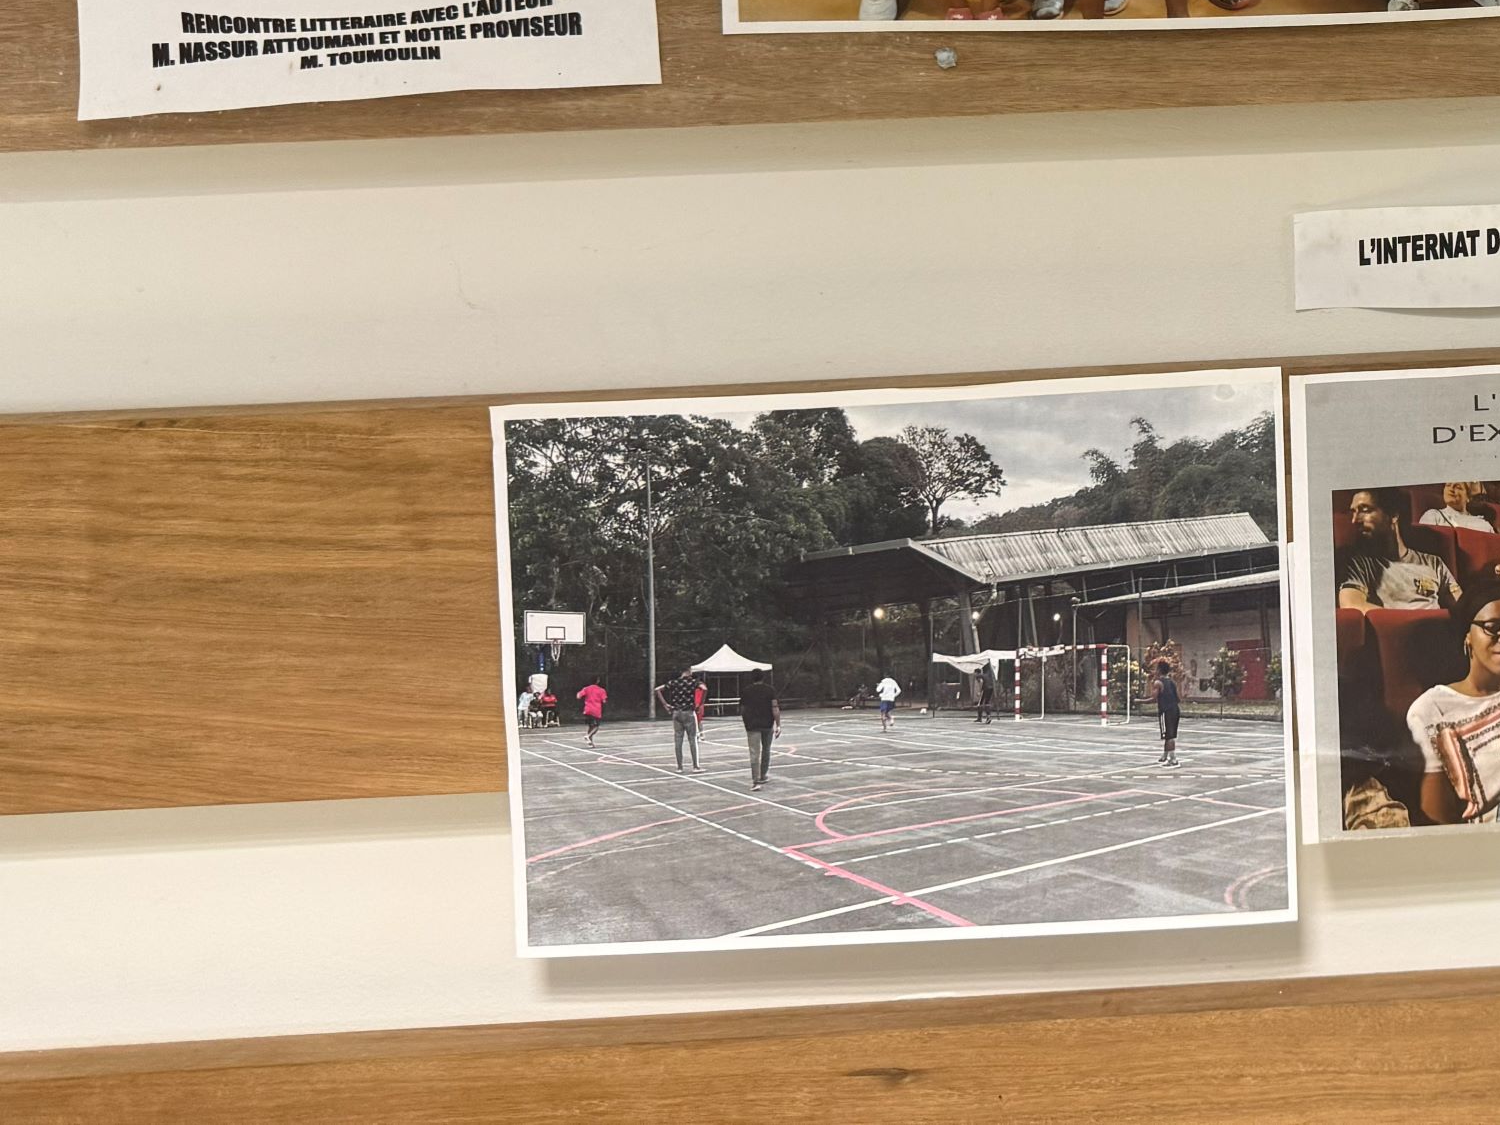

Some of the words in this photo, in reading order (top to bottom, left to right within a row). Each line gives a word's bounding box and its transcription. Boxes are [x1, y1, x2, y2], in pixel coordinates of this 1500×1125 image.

[180, 11, 298, 34] RENCONTRE
[299, 12, 408, 33] LITTERAIRE
[410, 4, 460, 24] AVEC
[151, 42, 177, 68] M.
[179, 39, 260, 65] NASSUR
[262, 31, 376, 55] ATTOUMANI
[379, 30, 401, 46] ET
[404, 25, 467, 43] NOTRE
[470, 11, 584, 40] PROVISEUR
[300, 55, 324, 70] M.
[326, 45, 442, 67] TOUMOULIN
[1358, 229, 1480, 266] L'INTERNAT
